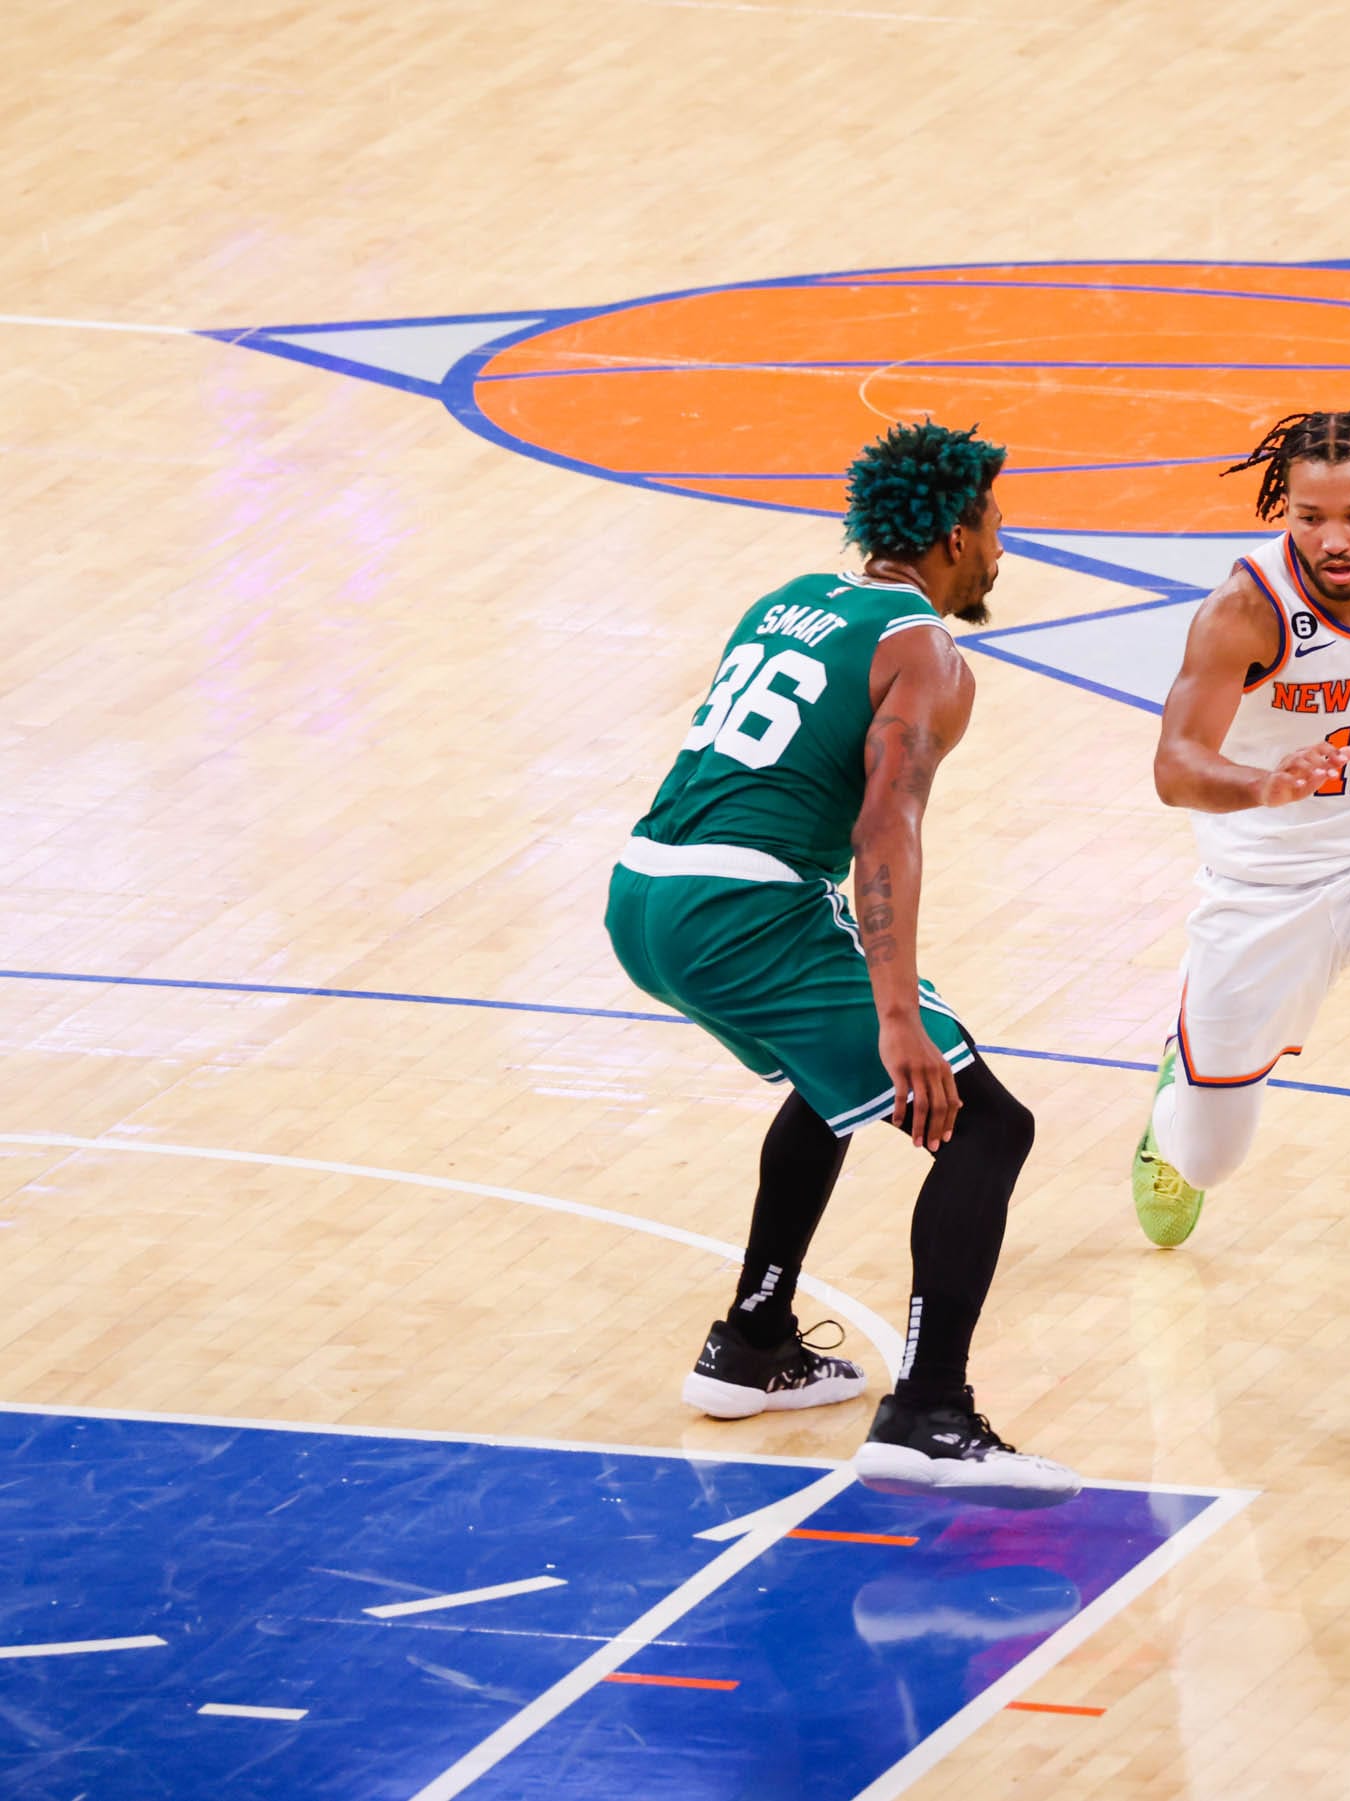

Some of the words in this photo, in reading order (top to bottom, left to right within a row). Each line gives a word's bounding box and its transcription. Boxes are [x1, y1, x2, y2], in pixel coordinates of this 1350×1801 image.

[756, 604, 848, 648] SMART
[1295, 615, 1312, 637] 6
[681, 643, 828, 769] 36
